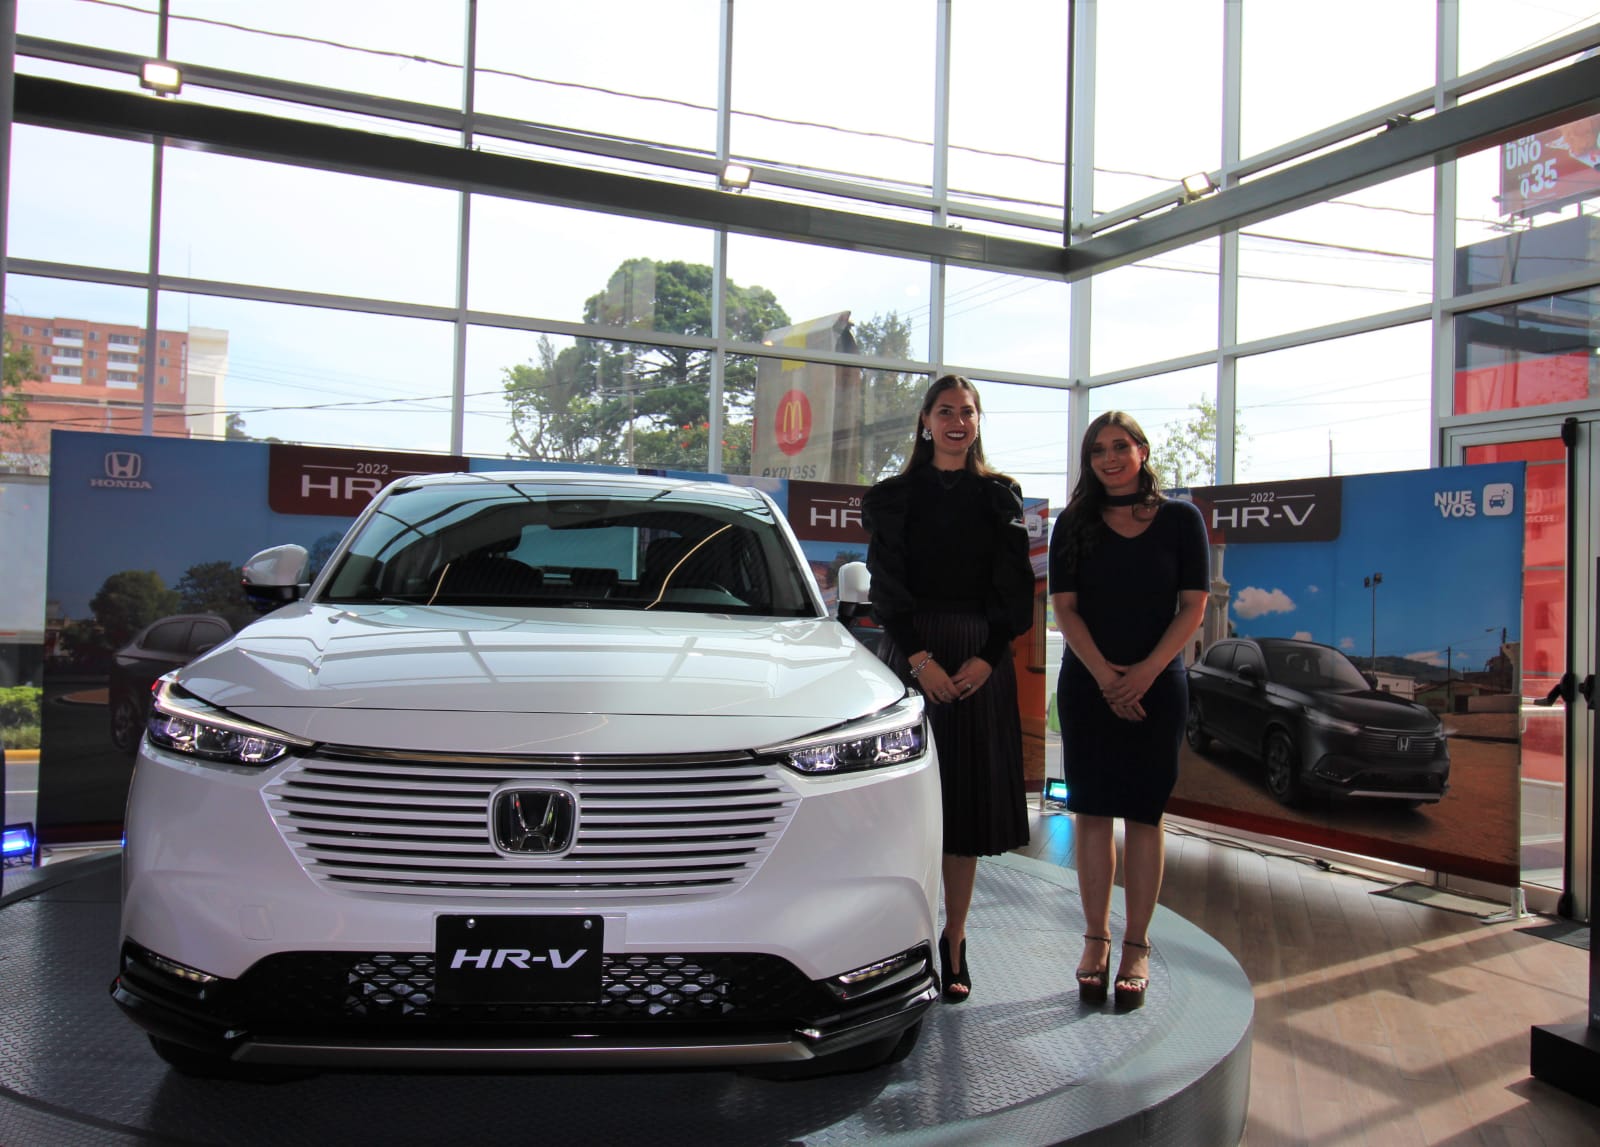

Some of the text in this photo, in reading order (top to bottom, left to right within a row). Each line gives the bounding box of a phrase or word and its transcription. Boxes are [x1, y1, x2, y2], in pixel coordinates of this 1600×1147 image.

[1505, 140, 1542, 170] UNO
[356, 463, 389, 475] 2022
[90, 479, 152, 489] HONDA
[301, 474, 383, 500] HR
[848, 497, 863, 507] 20
[1250, 492, 1275, 503] 2022
[1434, 490, 1472, 507] NUE
[810, 507, 863, 528] HR
[1212, 503, 1316, 529] HR-V
[1440, 503, 1476, 518] VOS
[450, 949, 588, 969] HR-V
